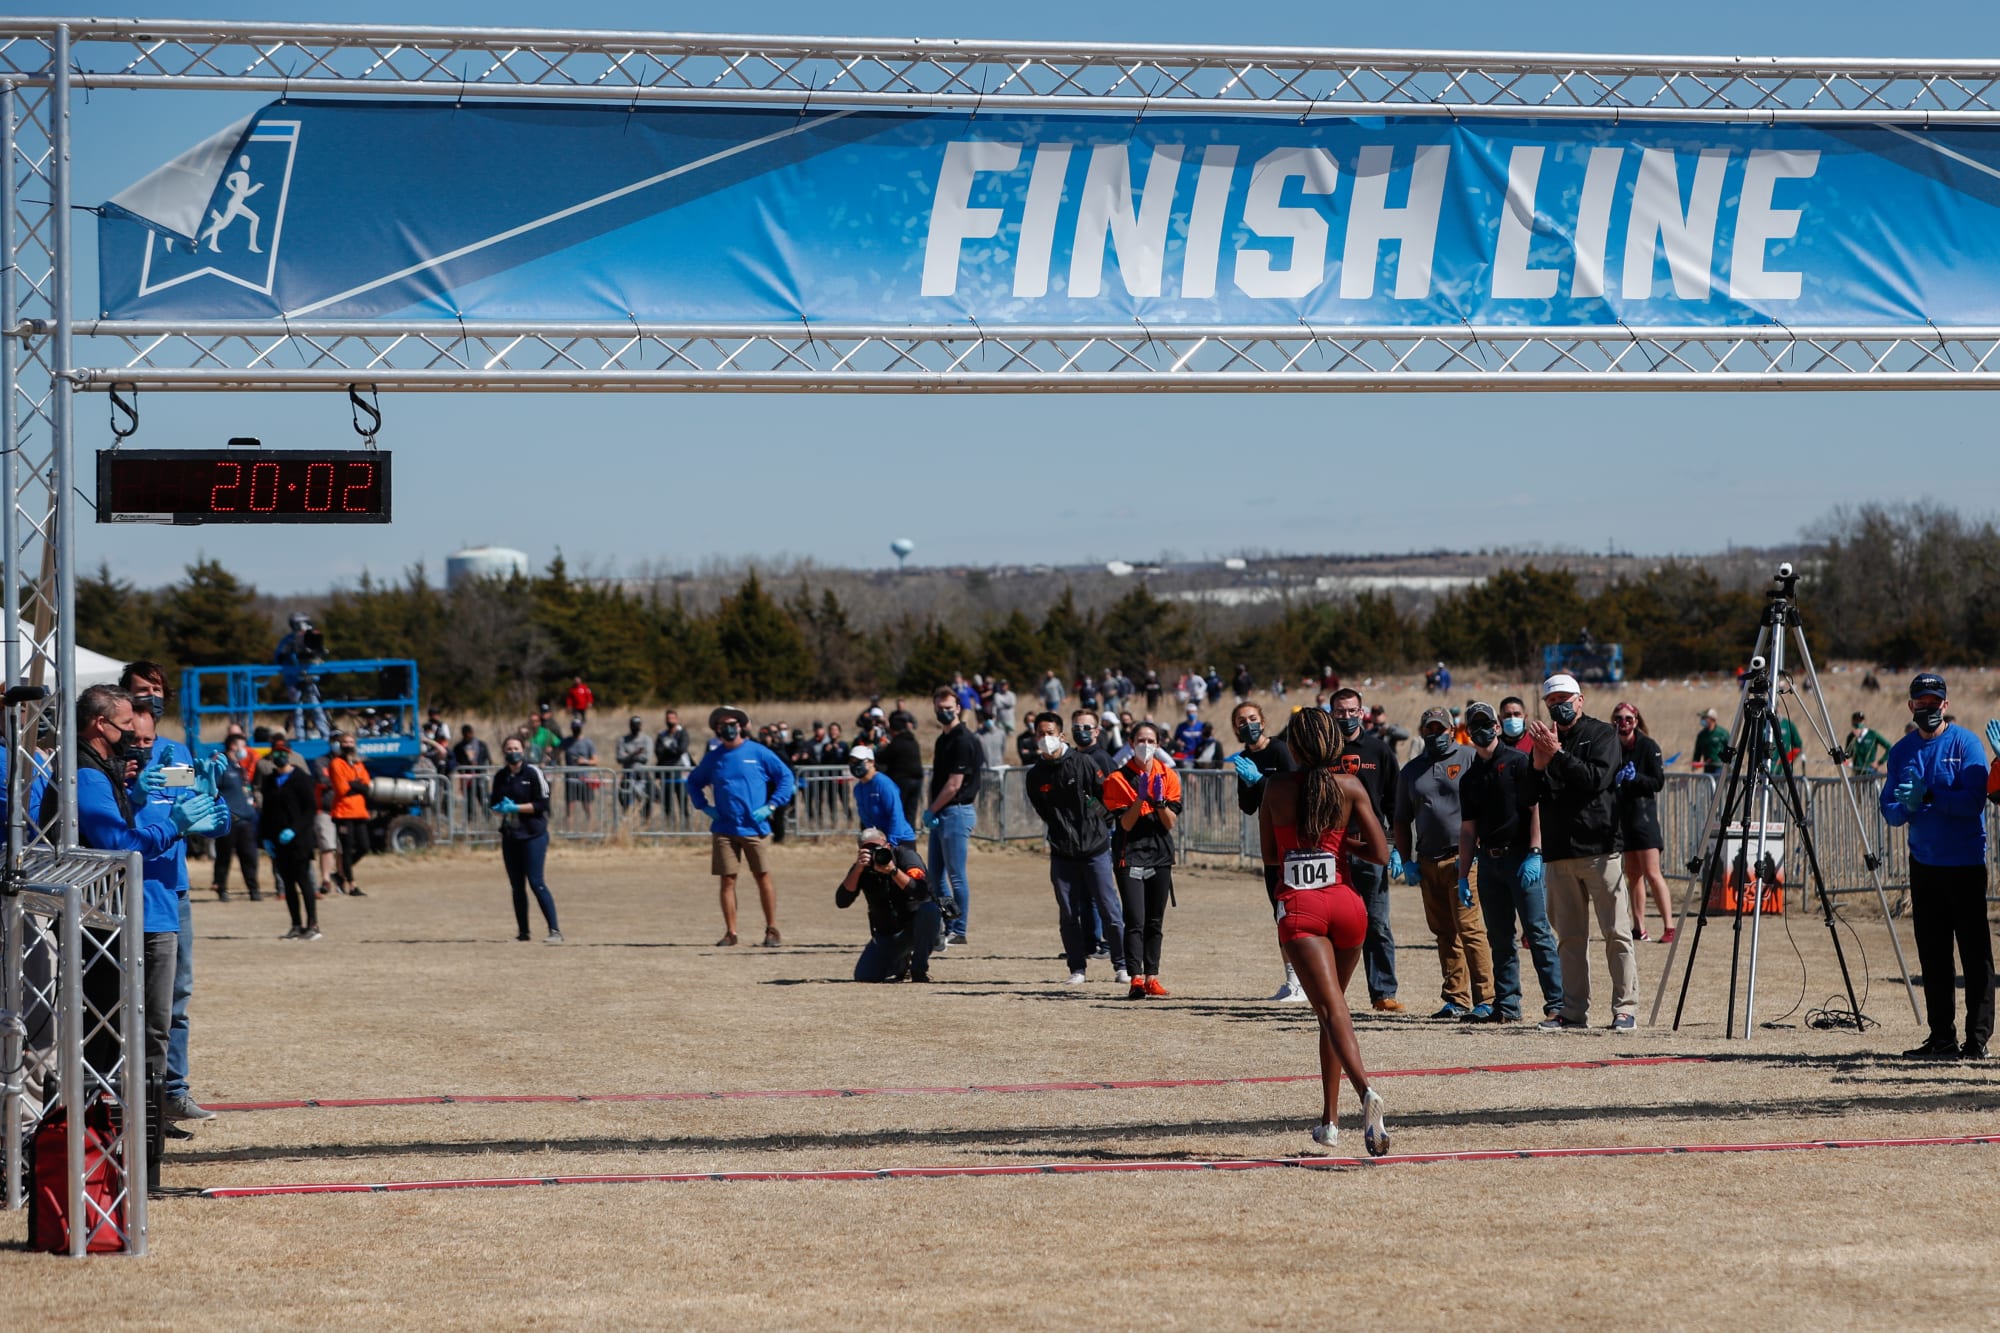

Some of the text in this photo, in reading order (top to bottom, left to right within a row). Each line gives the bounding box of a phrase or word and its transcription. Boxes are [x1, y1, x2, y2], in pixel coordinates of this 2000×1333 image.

[920, 141, 1821, 300] FINISH LINE
[1291, 862, 1329, 886] 104
